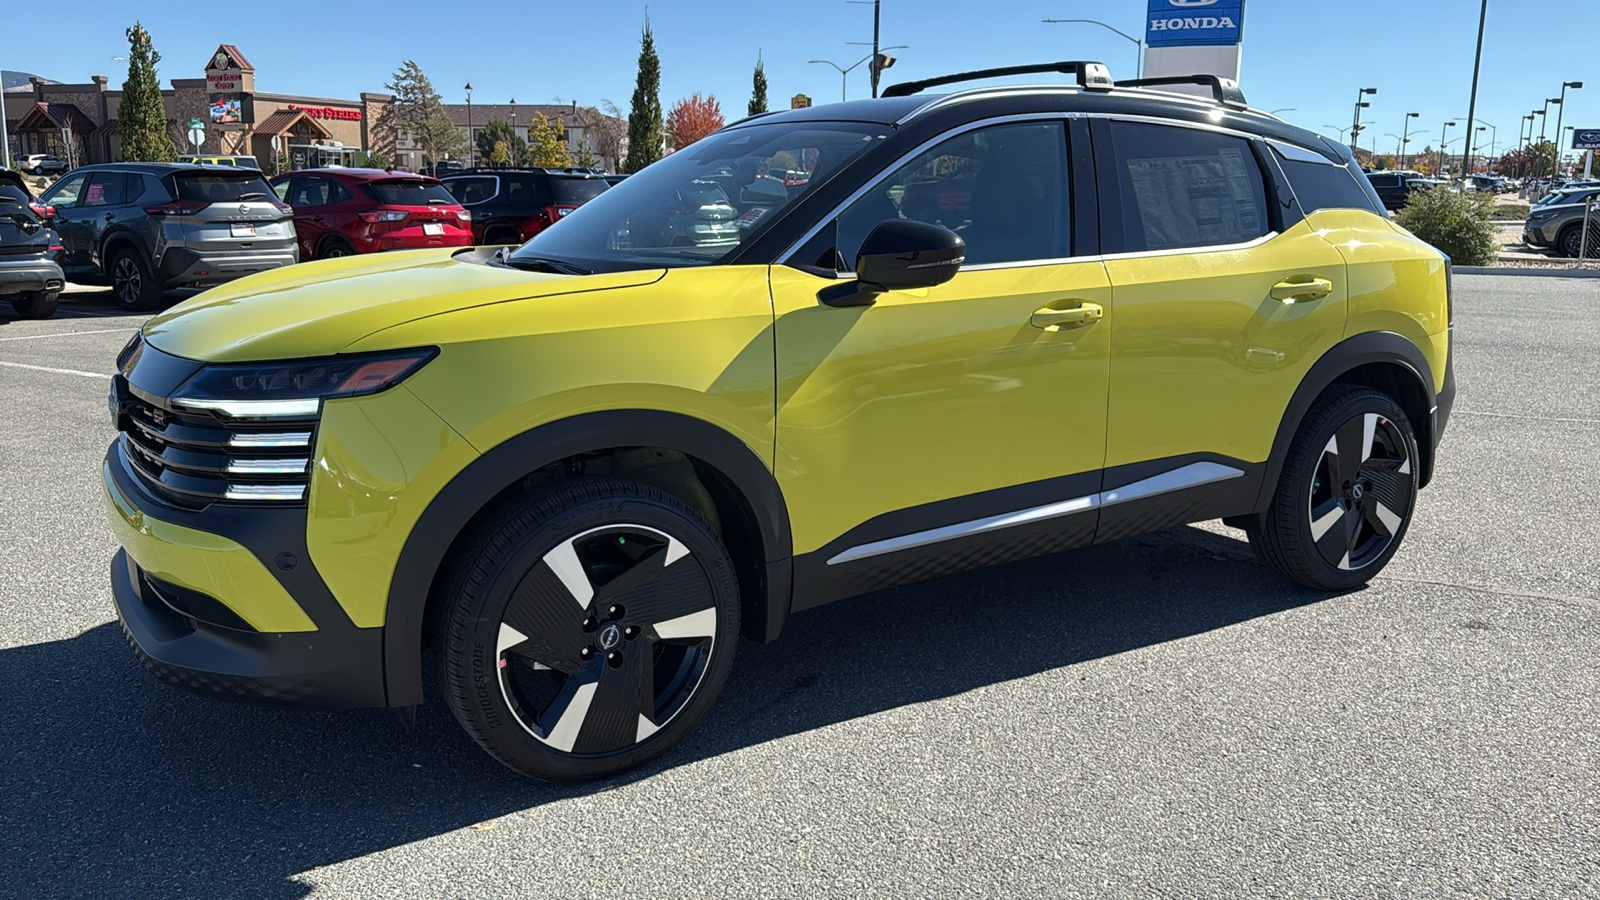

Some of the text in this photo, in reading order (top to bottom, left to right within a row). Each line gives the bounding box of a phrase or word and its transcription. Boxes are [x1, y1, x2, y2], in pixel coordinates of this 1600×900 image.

[1150, 17, 1236, 31] HONDA
[325, 106, 362, 121] STRIKE
[562, 501, 614, 522] ALENZA
[714, 557, 735, 635] BRIDGESTONE
[472, 641, 501, 728] BRIDGESTONE
